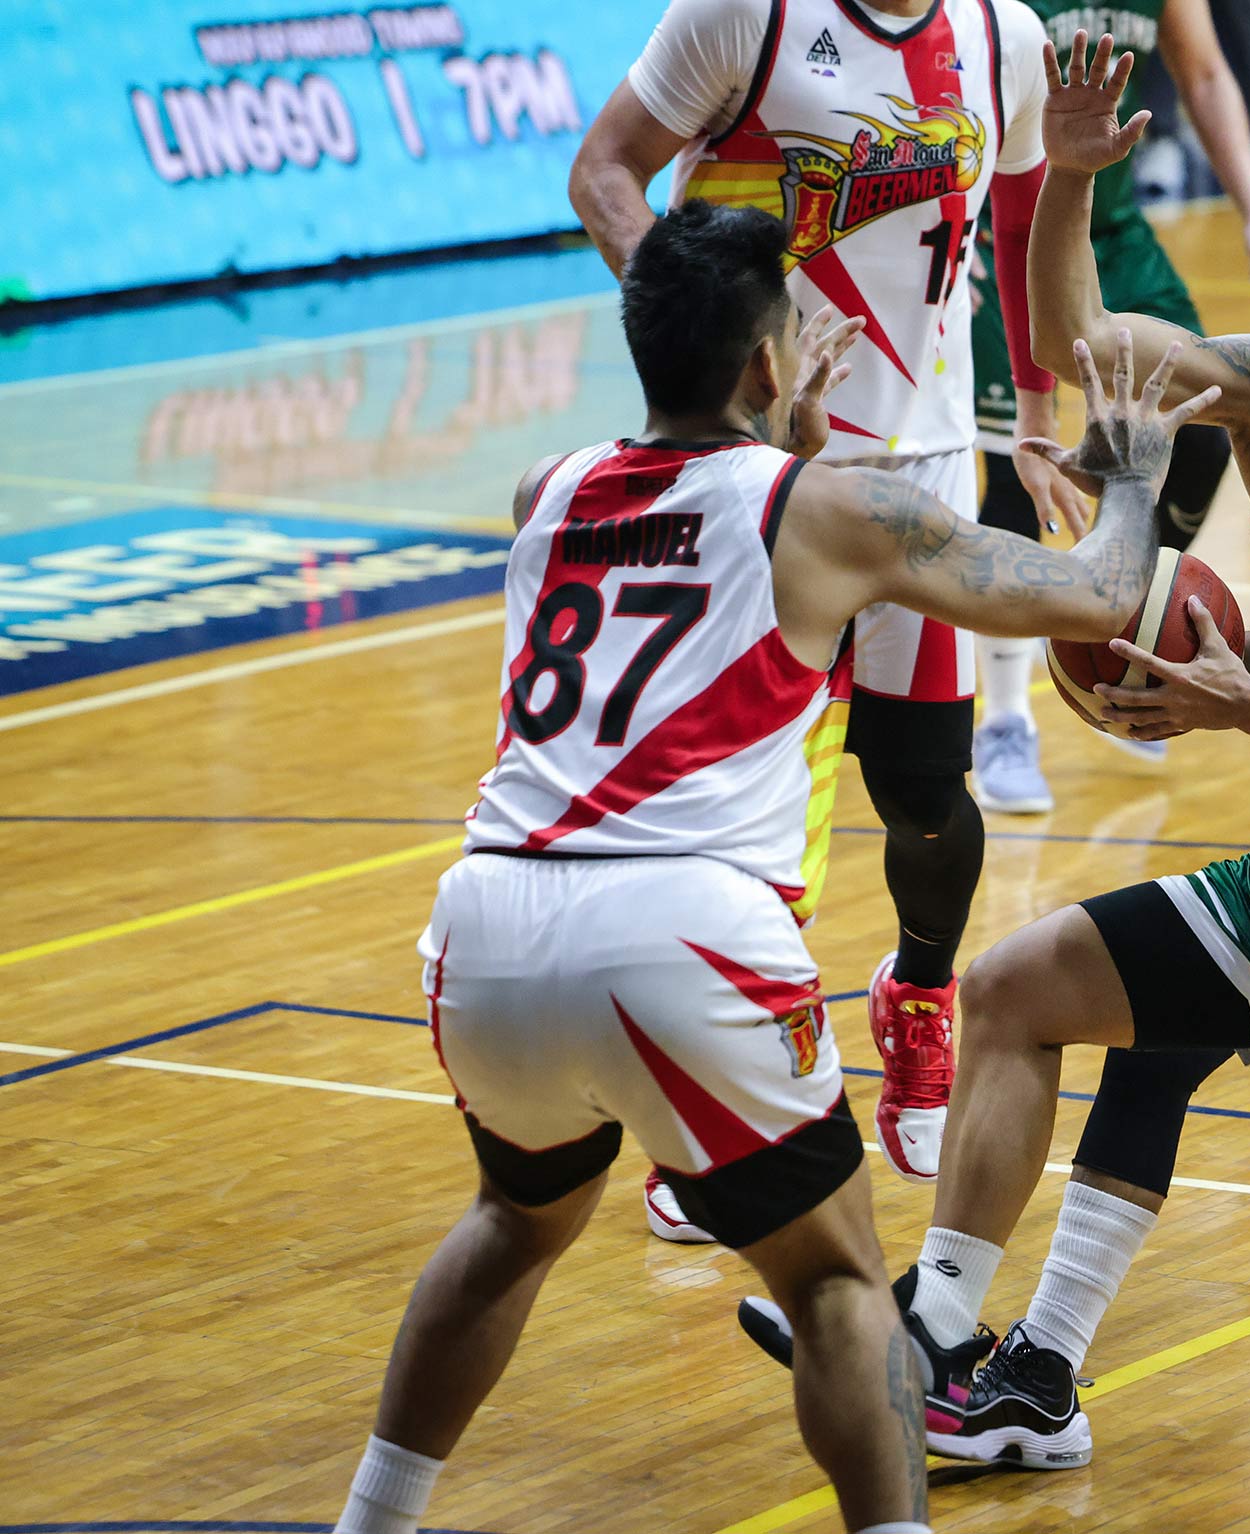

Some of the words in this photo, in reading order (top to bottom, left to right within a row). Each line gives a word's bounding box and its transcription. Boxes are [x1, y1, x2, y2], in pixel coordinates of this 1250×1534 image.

[806, 53, 841, 66] DELTA
[130, 73, 358, 183] LINGGO
[443, 46, 583, 145] 7PM
[851, 130, 891, 171] San
[888, 137, 956, 168] Miguel
[843, 163, 958, 228] BEERMEN
[562, 512, 704, 568] MANUEL
[507, 581, 712, 747] 87
